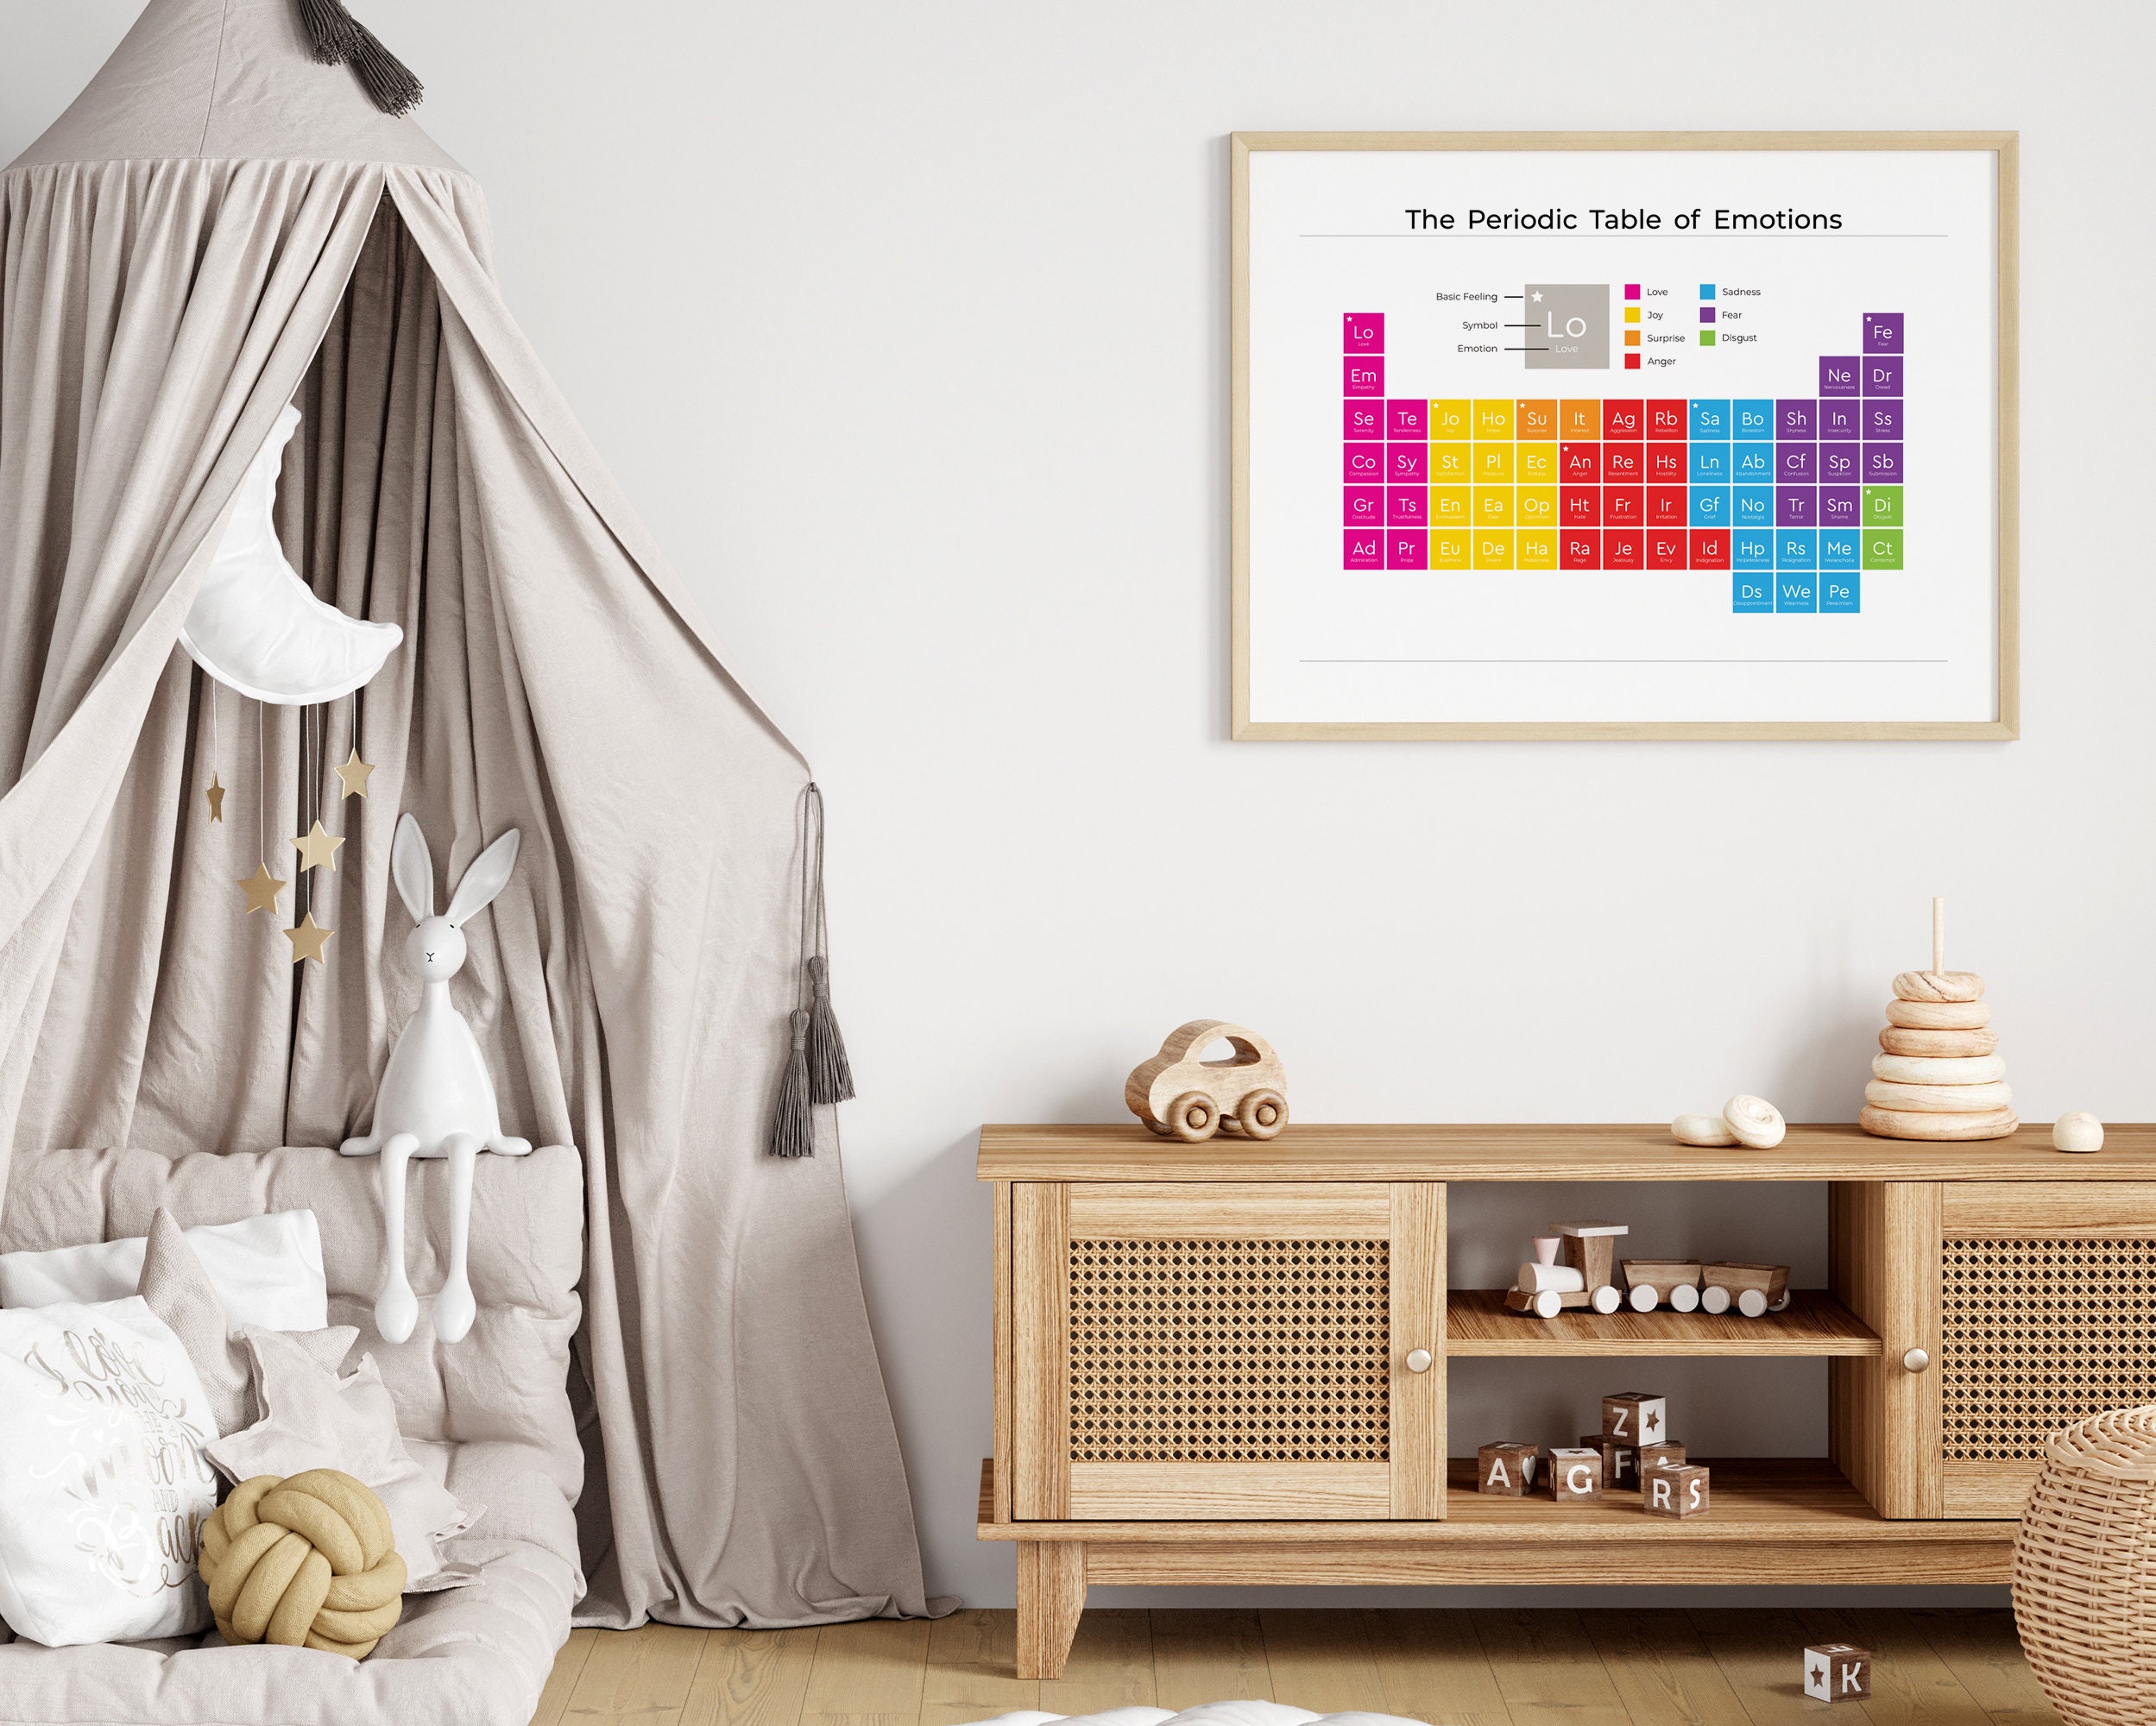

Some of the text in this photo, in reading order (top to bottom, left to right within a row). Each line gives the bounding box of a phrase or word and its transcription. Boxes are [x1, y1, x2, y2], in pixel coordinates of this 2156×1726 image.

[1404, 208, 1843, 230] The Periodic Table of Emotions
[1436, 293, 1498, 304] Basic Feeling
[1647, 287, 1668, 296] Love
[1722, 287, 1762, 296] Sadness
[1647, 311, 1664, 321] Joy
[1722, 311, 1743, 319] Fear
[1462, 321, 1498, 331] Symbol
[1548, 311, 1587, 338] Lo
[1354, 325, 1373, 339] Lo
[1647, 334, 1686, 344] Surprise
[1722, 333, 1757, 344] Disgust
[1874, 325, 1892, 339] Fe
[1457, 344, 1498, 353] Emotion
[1555, 344, 1579, 353] Love
[1647, 357, 1676, 368] Anger
[1351, 369, 1376, 382] Em
[1828, 369, 1850, 382] Ne
[1873, 369, 1892, 382] Dr
[1353, 412, 1373, 425] Se
[1397, 412, 1416, 425] Te
[1441, 412, 1459, 425] Jo
[1482, 412, 1505, 425] Ho
[1527, 411, 1547, 425] Su
[1611, 412, 1635, 429] Ag
[1655, 410, 1677, 425] Rb
[1700, 411, 1719, 425] Sa
[1742, 412, 1763, 425] Bo
[1787, 410, 1806, 425] Sh
[1874, 411, 1891, 425] Ss
[1352, 455, 1375, 469] Co
[1396, 455, 1416, 472] Sy
[1442, 455, 1458, 469] St
[1527, 455, 1546, 469] Ec
[1569, 455, 1591, 469] An
[1613, 455, 1633, 469] Re
[1656, 455, 1676, 469] Hs
[1700, 455, 1718, 469] Ln
[1741, 453, 1764, 469] Ab
[1787, 453, 1806, 469] Cf
[1829, 455, 1850, 472] Sp
[1872, 453, 1893, 469] Sb
[1353, 498, 1374, 512] Gr
[1398, 498, 1415, 512] Ts
[1440, 498, 1459, 512] En
[1484, 498, 1503, 512] Ea
[1523, 498, 1549, 515] Op
[1570, 498, 1589, 512] Ht
[1615, 498, 1630, 512] Fr
[1699, 496, 1719, 512] Gf
[1741, 498, 1764, 512] No
[1787, 498, 1805, 512] Tr
[1827, 498, 1852, 512] Sm
[1875, 497, 1890, 512] Di
[1352, 539, 1375, 555] Ad
[1398, 541, 1415, 555] Pr
[1440, 541, 1459, 555] Eu
[1482, 541, 1504, 555] De
[1526, 541, 1547, 555] Ha
[1570, 541, 1589, 555] Ra
[1615, 541, 1631, 555] Je
[1656, 541, 1675, 555] Ev
[1741, 541, 1764, 558] Hp
[1787, 541, 1805, 555] Rs
[1827, 541, 1851, 555] Me
[1872, 541, 1892, 555] Ct
[1742, 584, 1762, 598] Ds
[1782, 584, 1810, 598] We
[1830, 584, 1849, 598] Pe
[63, 1326, 166, 1388] love
[1612, 1407, 1629, 1438] Z
[1615, 1449, 1632, 1479] F
[1486, 1457, 1511, 1488] A
[1567, 1464, 1592, 1495] G
[1653, 1478, 1671, 1510] R
[1689, 1478, 1701, 1509] S
[1842, 1661, 1862, 1693] K
